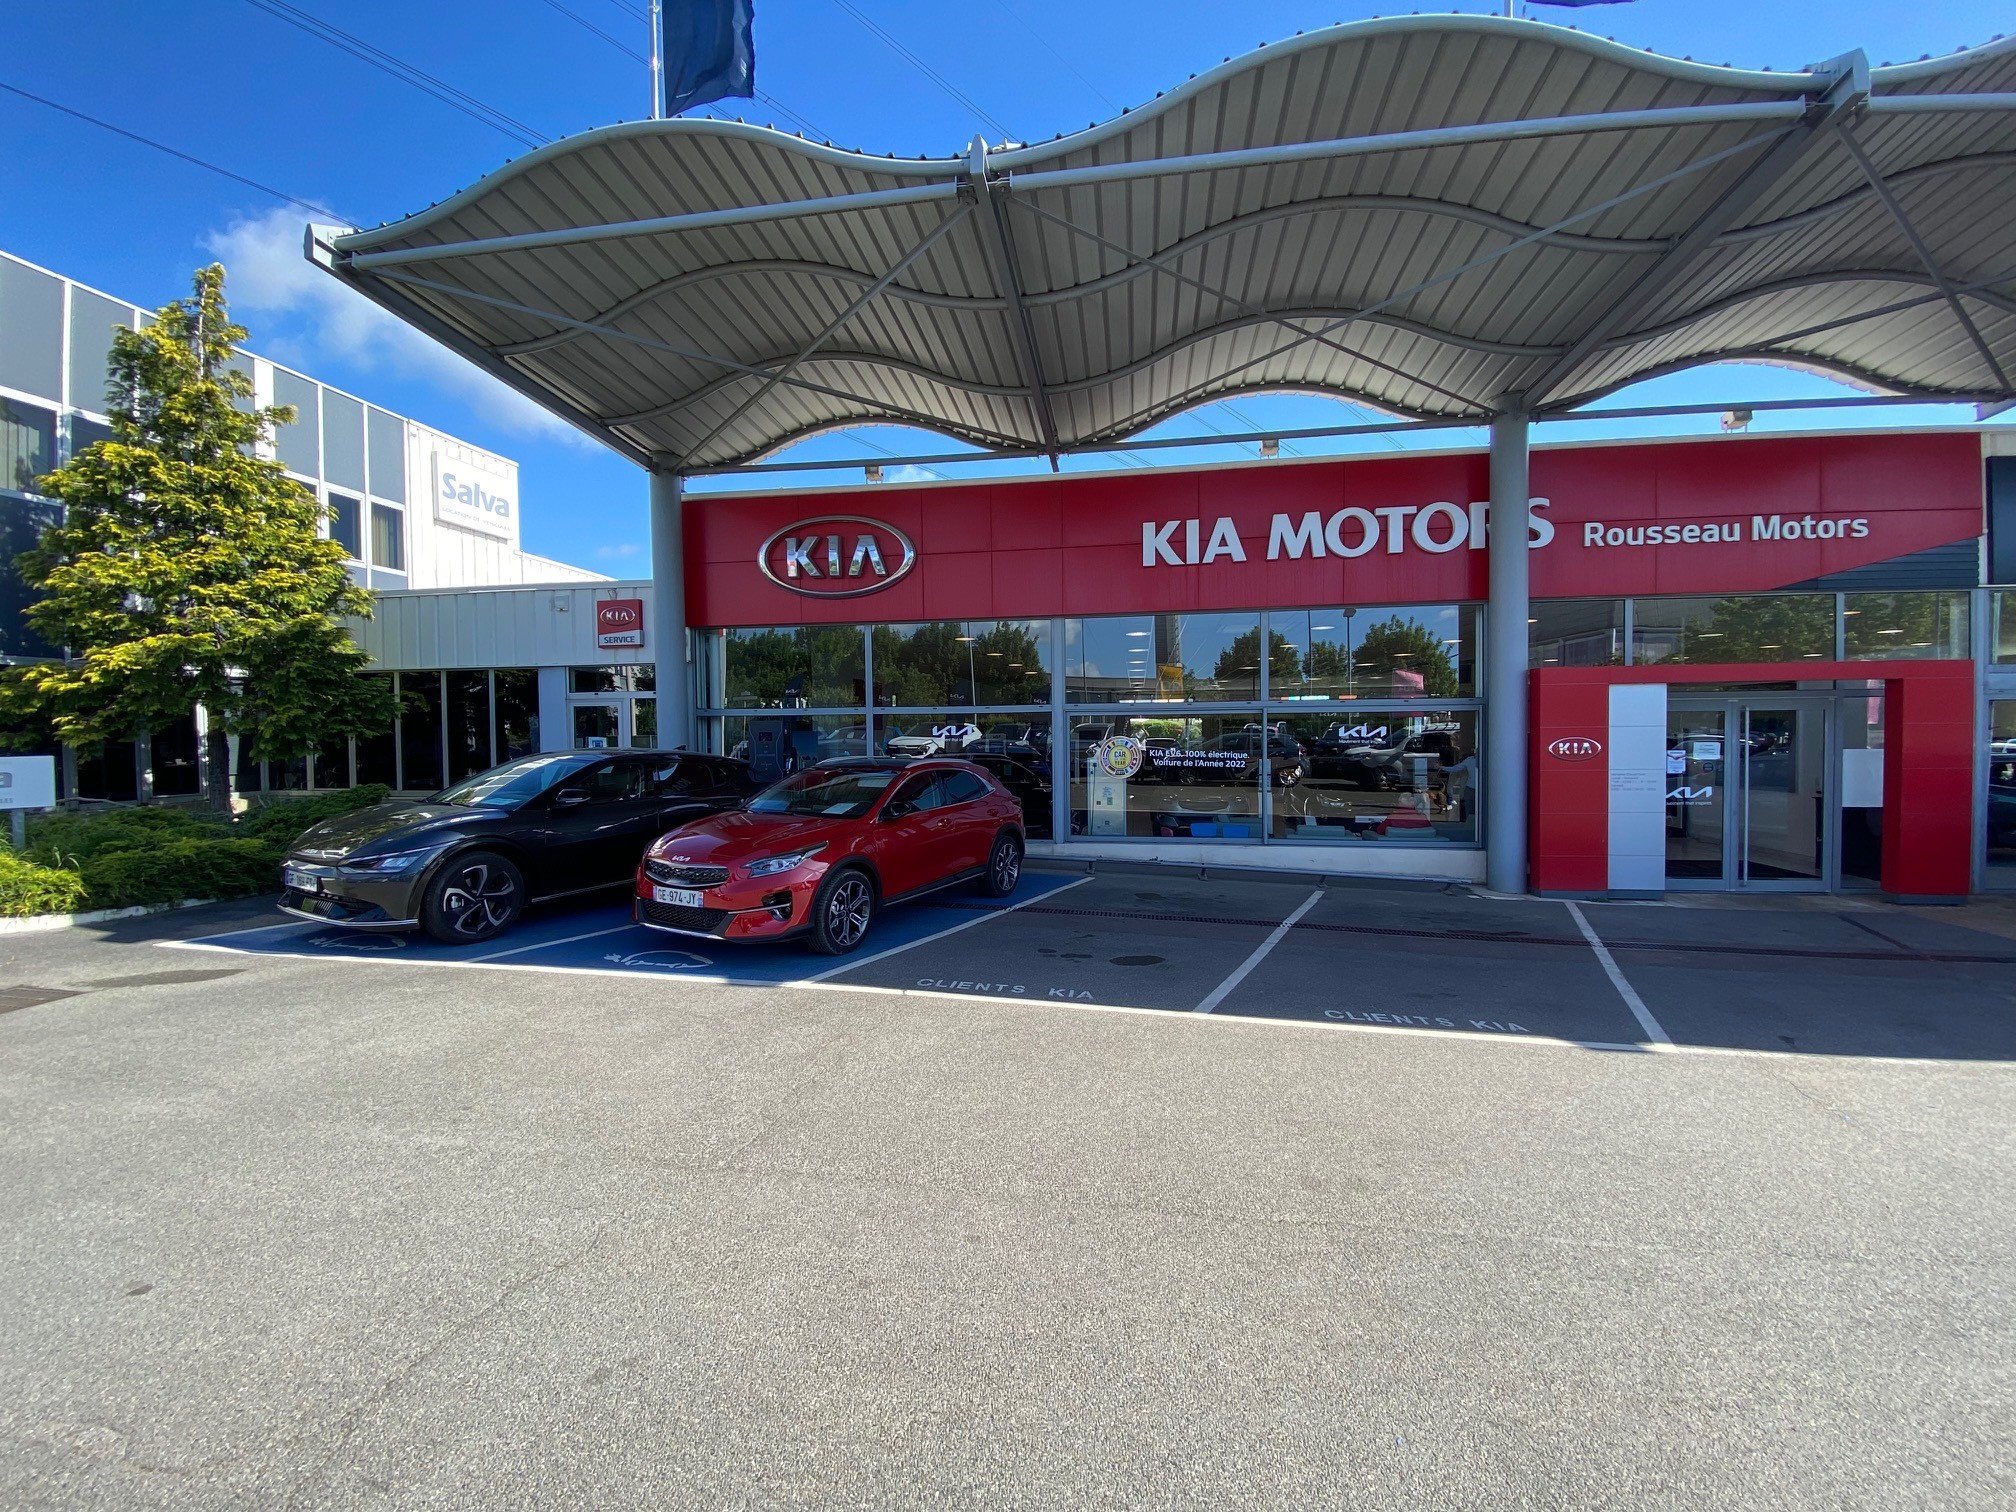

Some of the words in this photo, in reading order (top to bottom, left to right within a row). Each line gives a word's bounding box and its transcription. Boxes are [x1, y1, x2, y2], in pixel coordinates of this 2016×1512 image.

[443, 472, 510, 518] Salva
[1583, 522, 1740, 547] Rousseau
[1751, 514, 1869, 541] Motors
[1142, 517, 1248, 567] KIA
[785, 534, 888, 579] KIA
[606, 611, 629, 620] KIA
[1339, 725, 1387, 737] KIA
[1185, 750, 1207, 758] 100%
[1208, 750, 1250, 760] électrique.
[1558, 742, 1592, 755] KIA
[1153, 758, 1182, 767] Voiture
[1183, 759, 1194, 767] de
[1225, 760, 1246, 768] 2022
[657, 889, 697, 904] GE-974-JY
[916, 978, 1026, 993] CLIENTS
[1049, 988, 1096, 1000] KIA
[1324, 1009, 1455, 1027] CLIENTS
[1468, 1019, 1532, 1033] KIA
